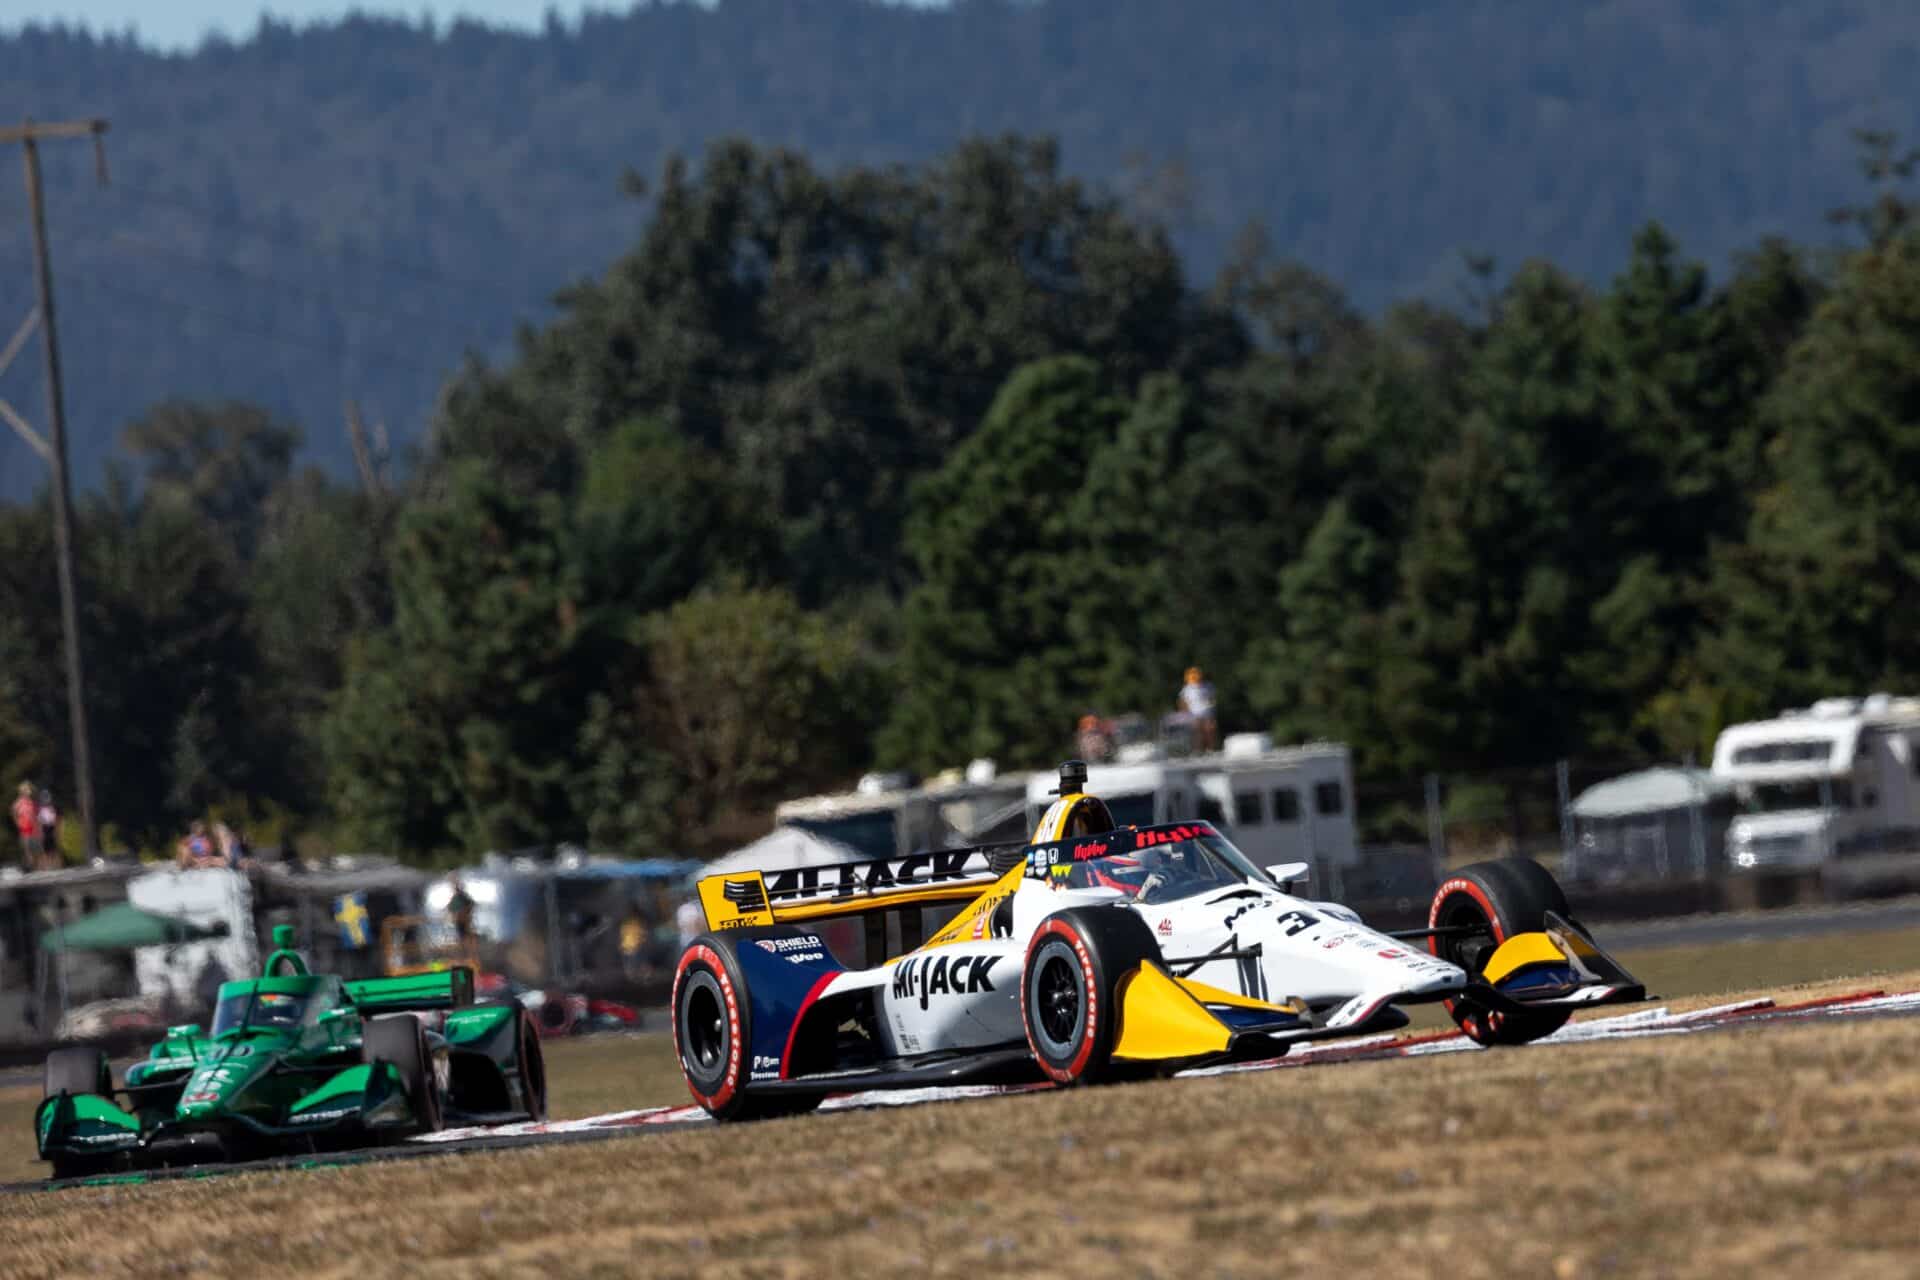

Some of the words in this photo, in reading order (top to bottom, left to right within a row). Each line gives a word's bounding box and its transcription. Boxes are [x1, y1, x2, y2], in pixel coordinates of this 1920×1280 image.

[775, 936, 819, 948] SHIELD
[893, 955, 1004, 1011] MI-JACK
[1075, 939, 1097, 1038] Firestone
[719, 973, 739, 1086] Firestone
